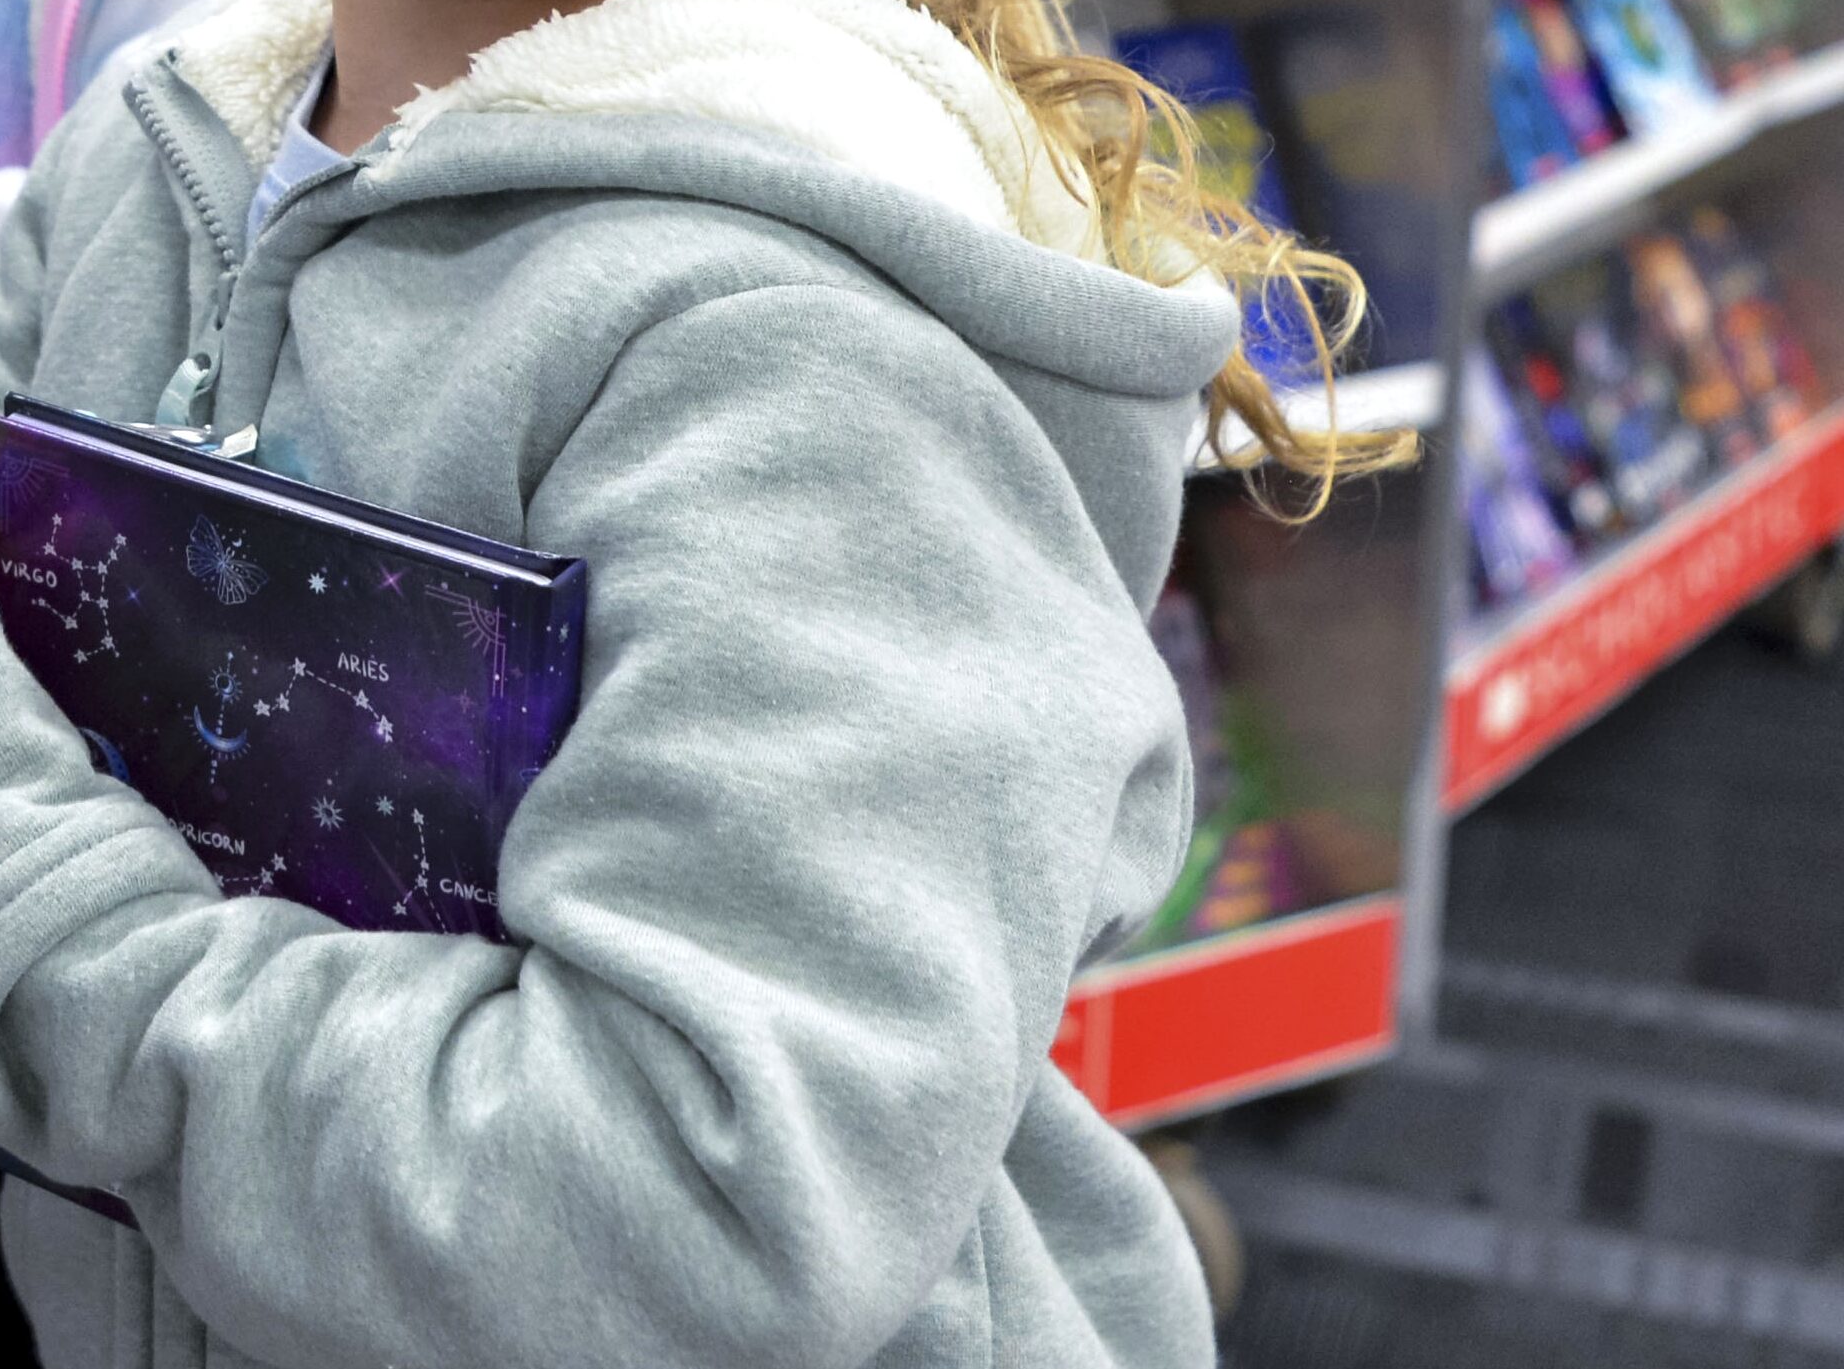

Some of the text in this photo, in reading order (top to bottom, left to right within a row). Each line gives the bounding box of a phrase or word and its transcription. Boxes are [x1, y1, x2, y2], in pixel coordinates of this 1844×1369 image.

[1, 558, 57, 588] VIRGO
[337, 652, 389, 682] ARIES
[168, 818, 245, 856] APRICORN
[439, 878, 500, 907] CANCE
